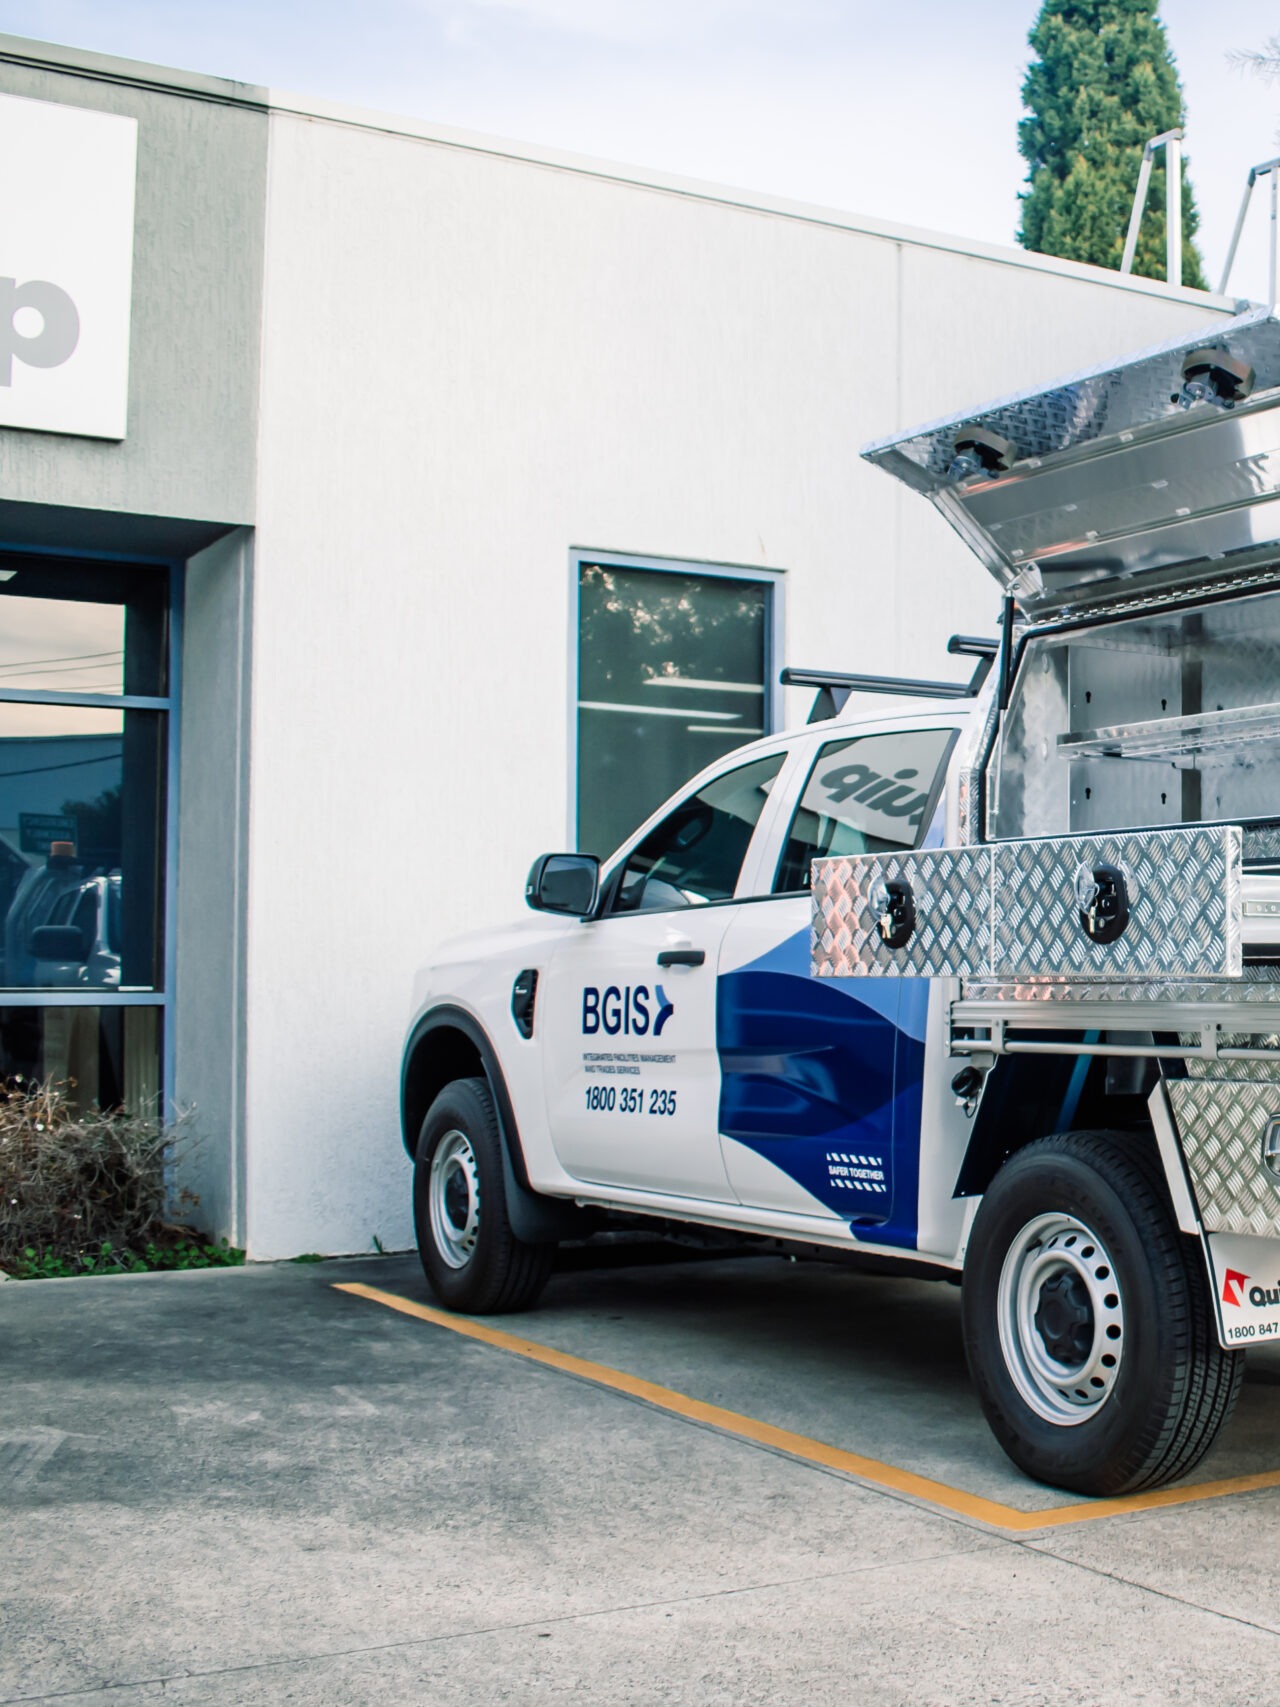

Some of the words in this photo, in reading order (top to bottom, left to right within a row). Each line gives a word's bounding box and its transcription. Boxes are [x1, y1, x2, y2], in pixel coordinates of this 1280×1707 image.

[582, 985, 650, 1035] BGIS
[640, 1054, 676, 1063] MANAGEMENT
[585, 1086, 616, 1111] 1800
[620, 1087, 644, 1113] 351
[649, 1089, 677, 1116] 235
[828, 1165, 849, 1176] SAFER
[849, 1168, 885, 1181] TOGETHER
[1228, 1325, 1256, 1339] 1800
[1259, 1322, 1279, 1335] 847
